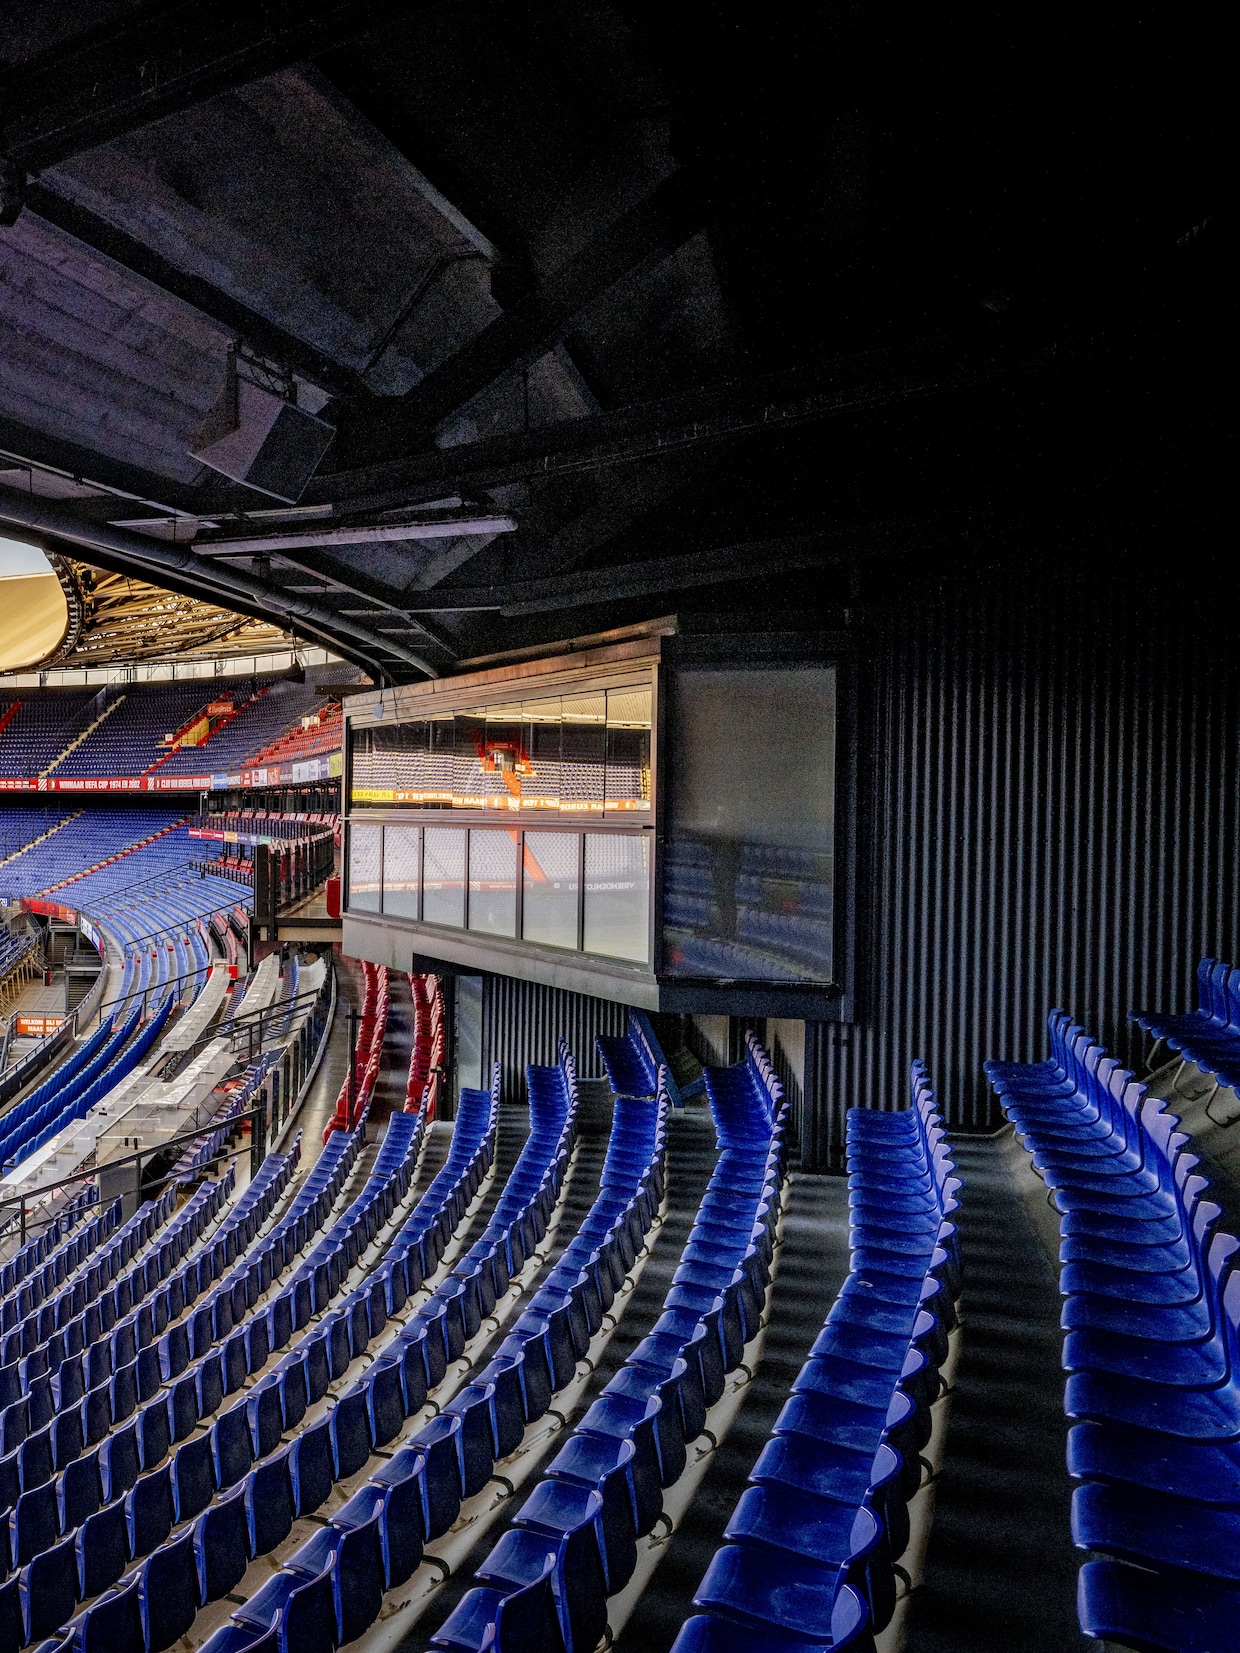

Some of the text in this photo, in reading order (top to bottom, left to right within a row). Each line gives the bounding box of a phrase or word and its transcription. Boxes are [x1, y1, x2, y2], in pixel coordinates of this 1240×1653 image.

[59, 780, 84, 789] WINNAAR
[85, 780, 98, 789] UEFA
[98, 780, 108, 788] CUP
[109, 780, 121, 788] 1974
